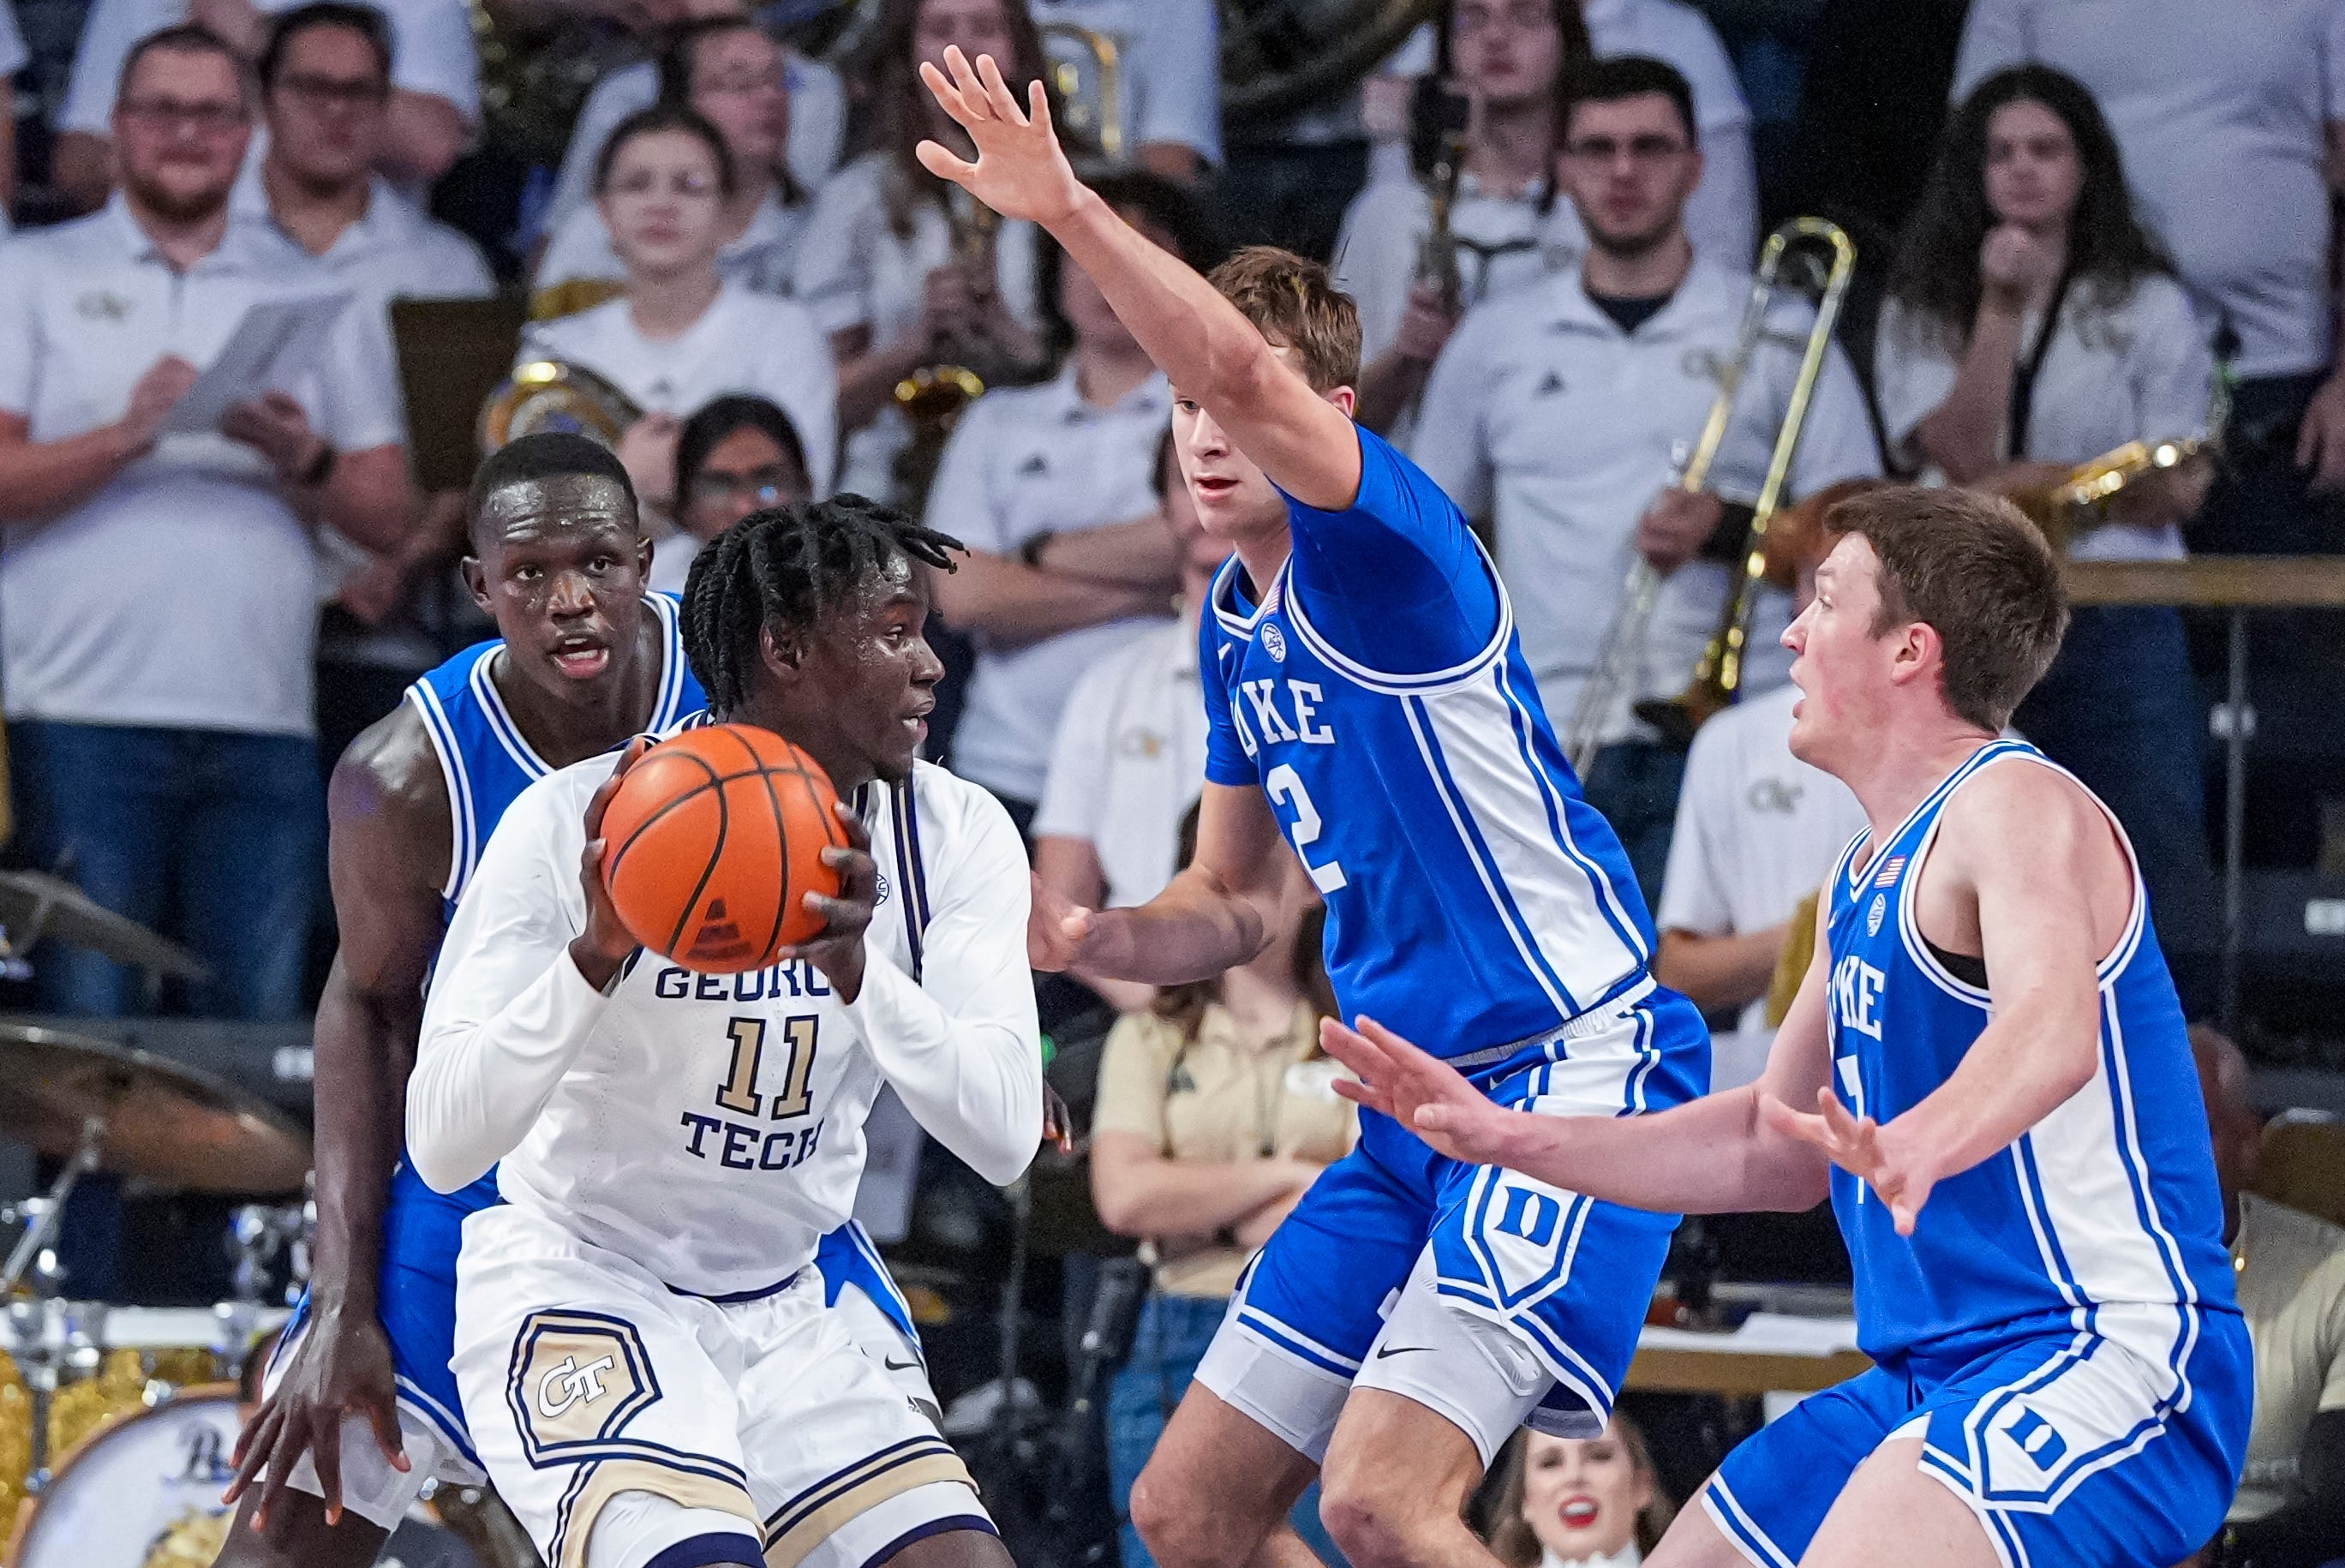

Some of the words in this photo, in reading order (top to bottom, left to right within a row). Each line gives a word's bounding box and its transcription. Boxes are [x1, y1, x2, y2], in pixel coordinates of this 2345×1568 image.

[1230, 678, 1336, 757] UKE
[1266, 763, 1348, 894] 2
[1825, 955, 1886, 1061] UKE
[715, 1014, 820, 1121] 11
[680, 1110, 825, 1171] TECH
[537, 1356, 616, 1418] GT
